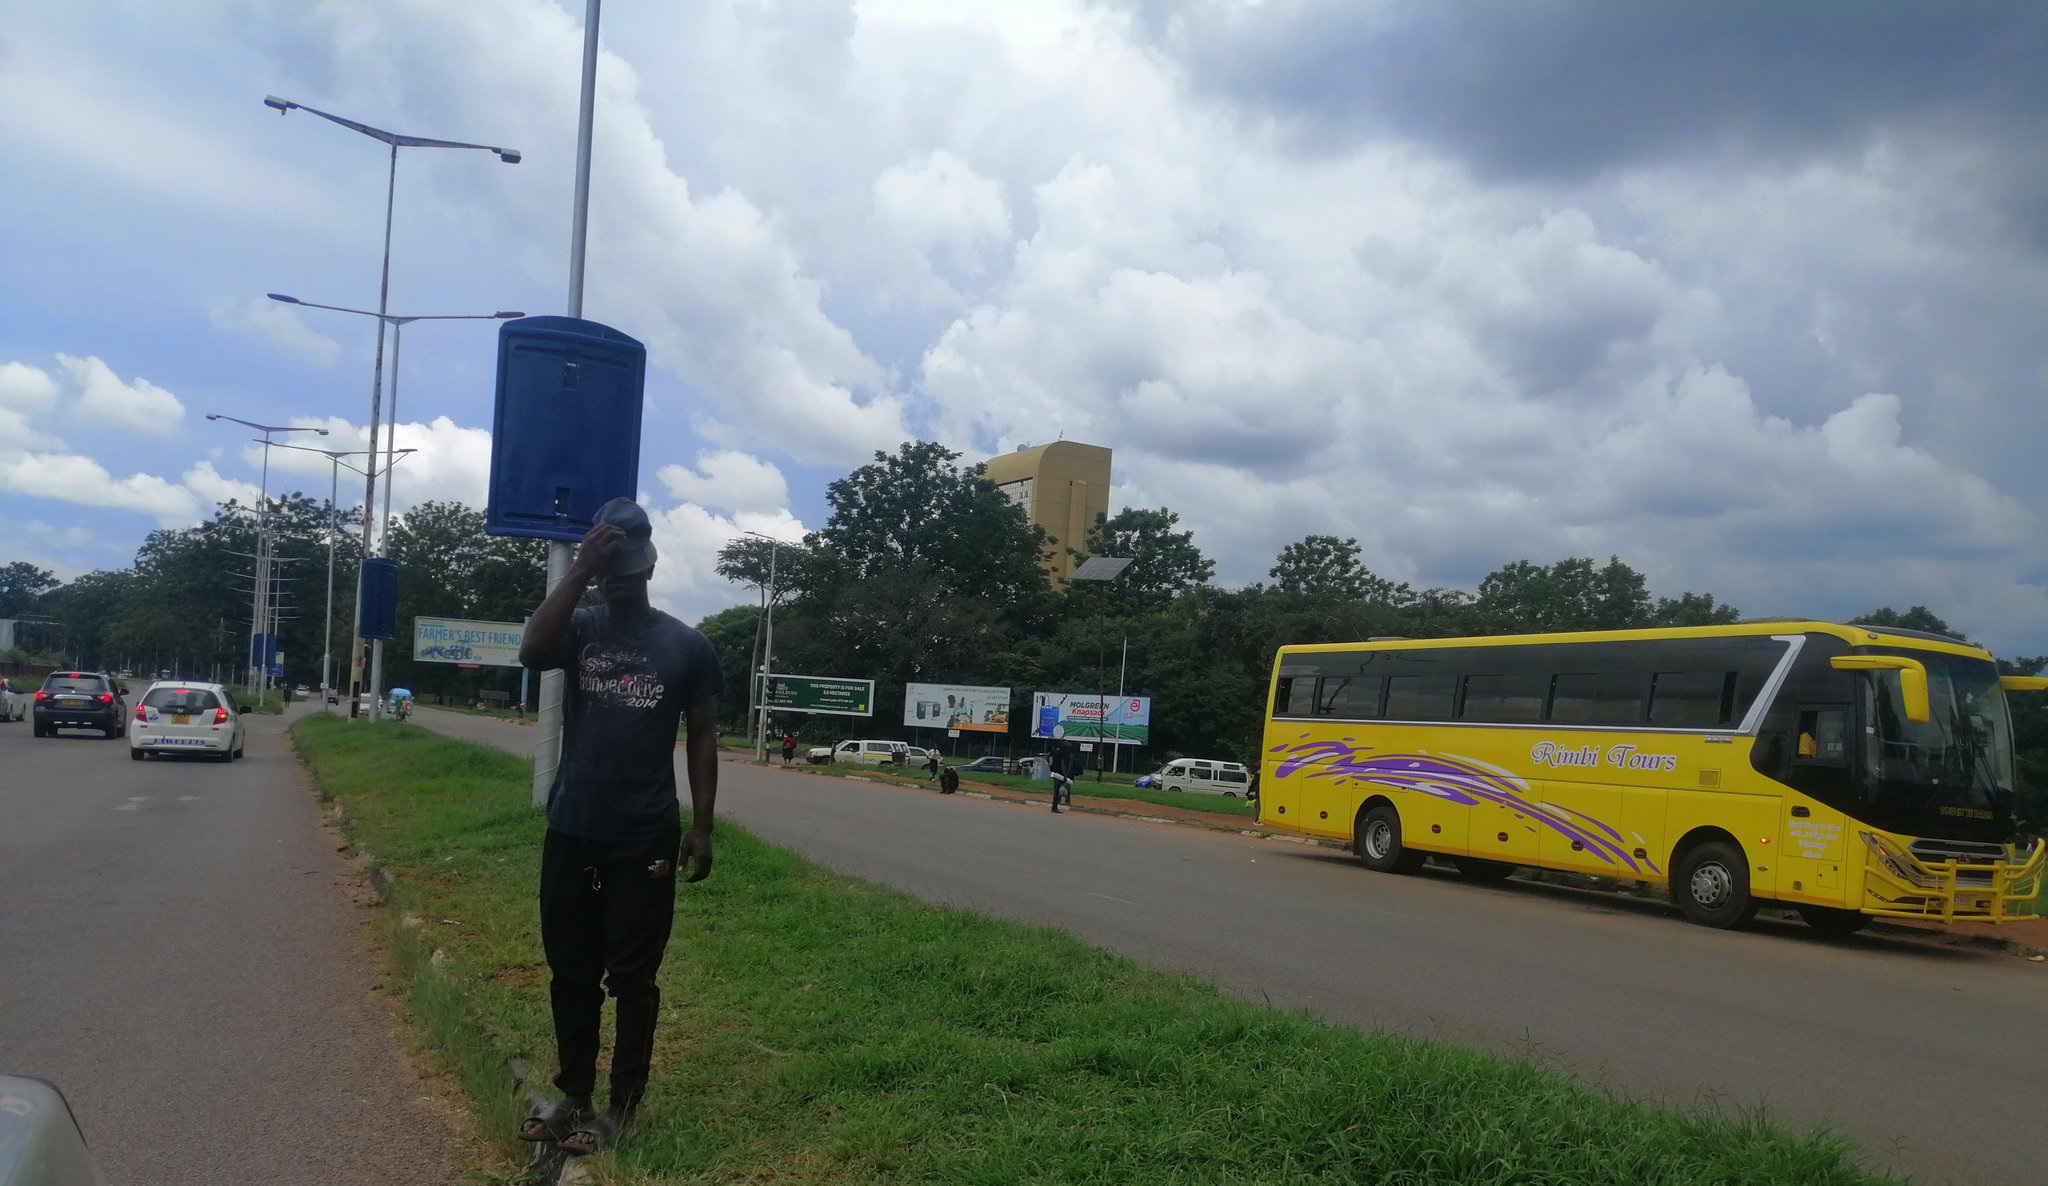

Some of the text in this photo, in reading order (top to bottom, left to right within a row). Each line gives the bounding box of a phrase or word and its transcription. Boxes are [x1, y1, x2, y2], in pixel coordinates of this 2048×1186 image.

[419, 627, 522, 645] FARMER'S BEST FRIEND
[626, 697, 658, 709] 2014
[1531, 742, 1677, 771] Rimbi Tours
